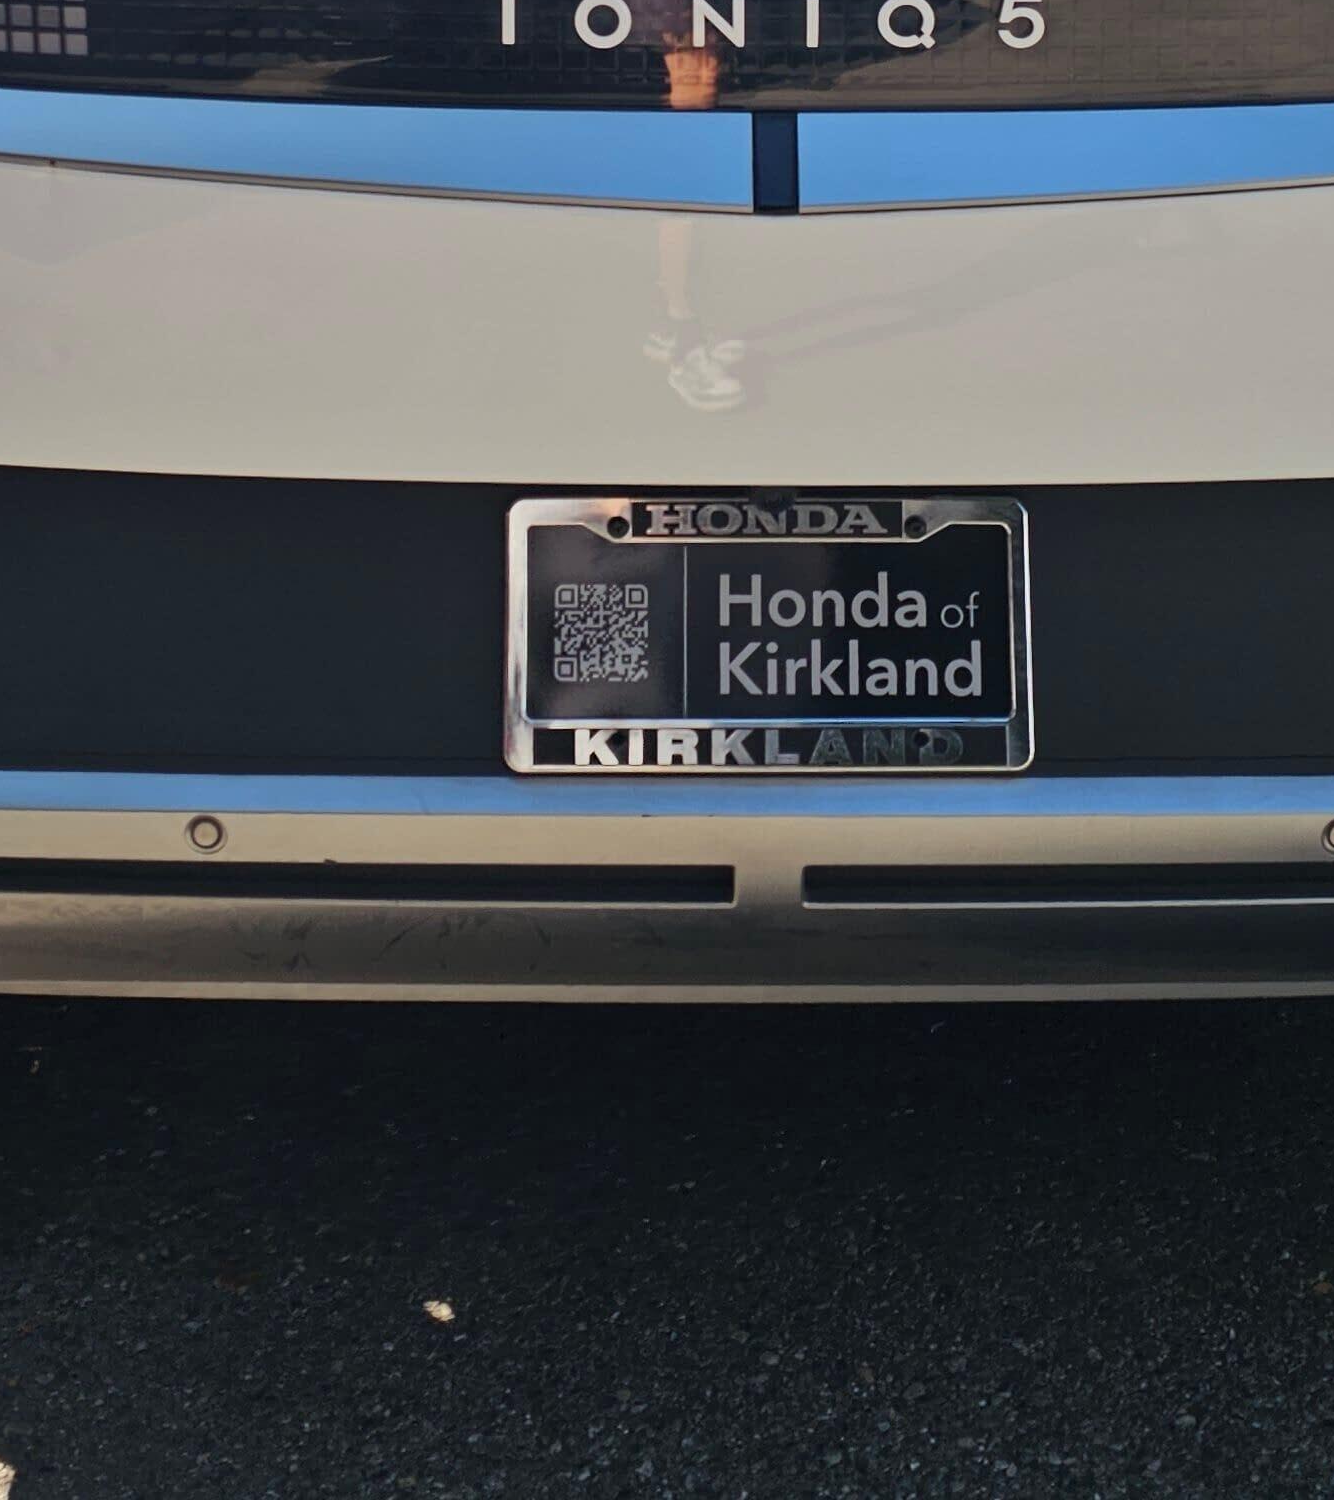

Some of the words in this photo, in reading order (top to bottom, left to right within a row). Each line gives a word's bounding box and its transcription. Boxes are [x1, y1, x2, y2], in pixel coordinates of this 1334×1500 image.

[644, 503, 888, 536] HONDA
[718, 570, 928, 628] Honda
[939, 591, 980, 629] of
[718, 639, 983, 697] Kirkland
[573, 728, 965, 766] KIRKLAND
